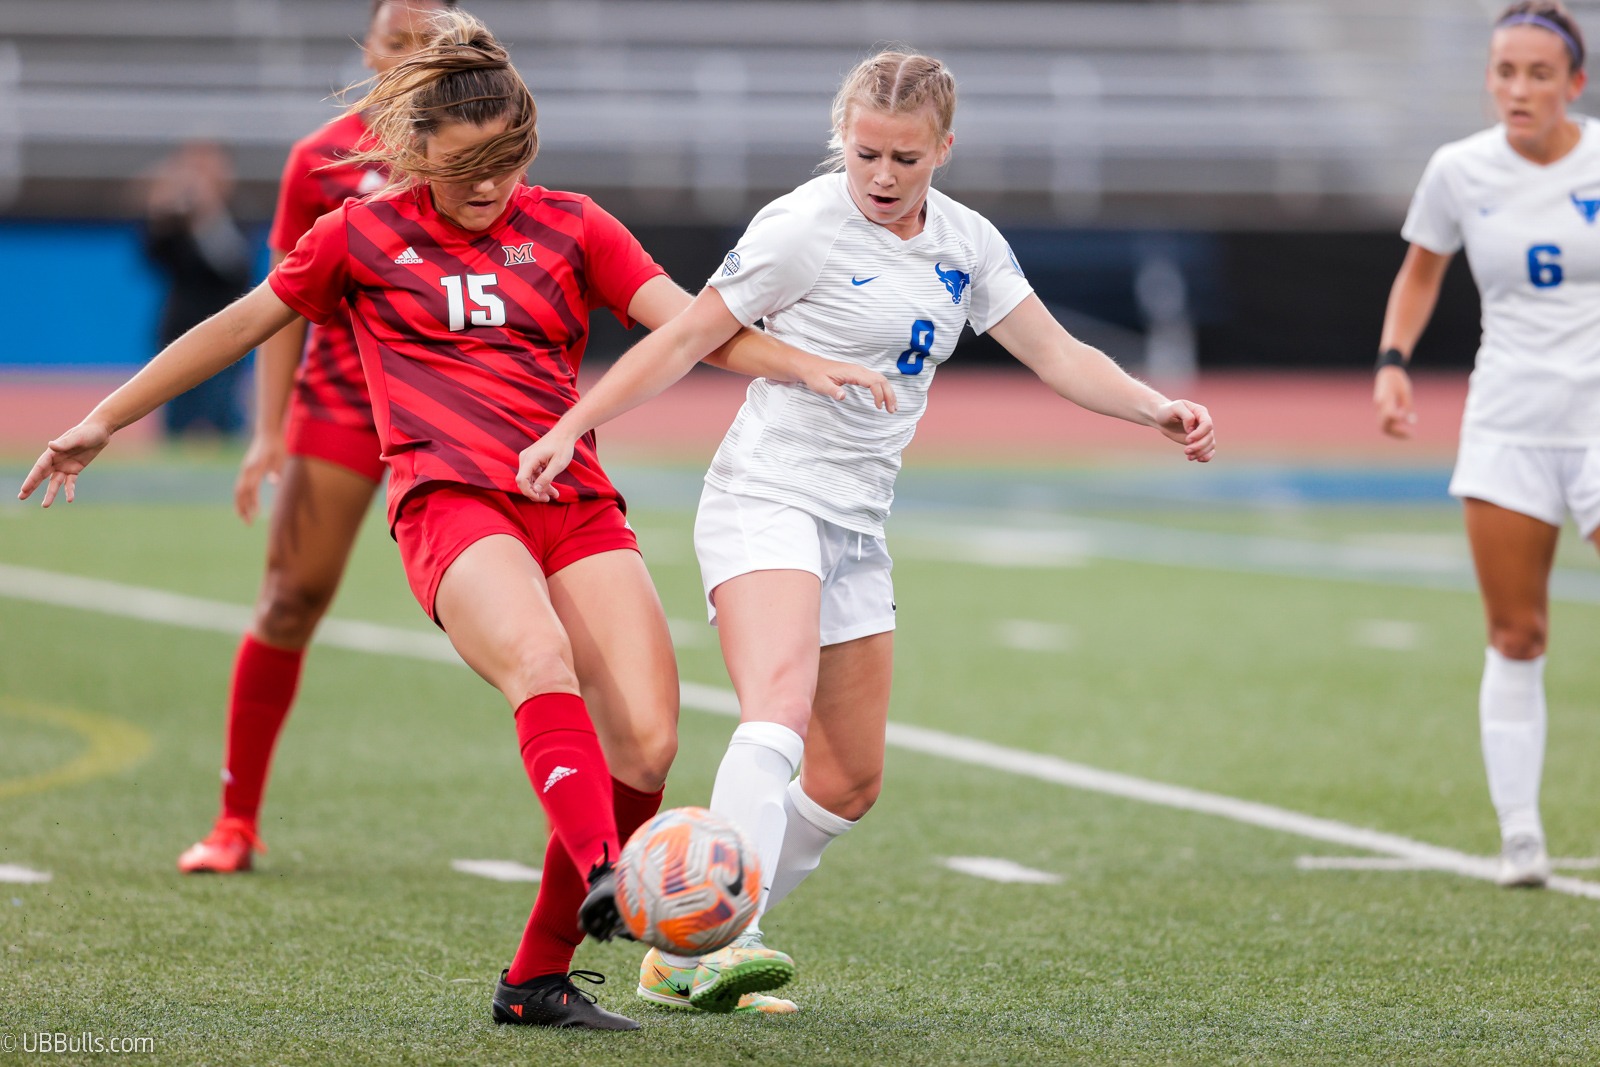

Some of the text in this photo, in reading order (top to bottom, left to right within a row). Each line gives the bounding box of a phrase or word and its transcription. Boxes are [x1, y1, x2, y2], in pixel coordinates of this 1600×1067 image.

[394, 257, 424, 265] adidas
[502, 243, 536, 266] M
[1527, 244, 1563, 288] 6
[439, 273, 507, 332] 15
[896, 319, 936, 375] 8
